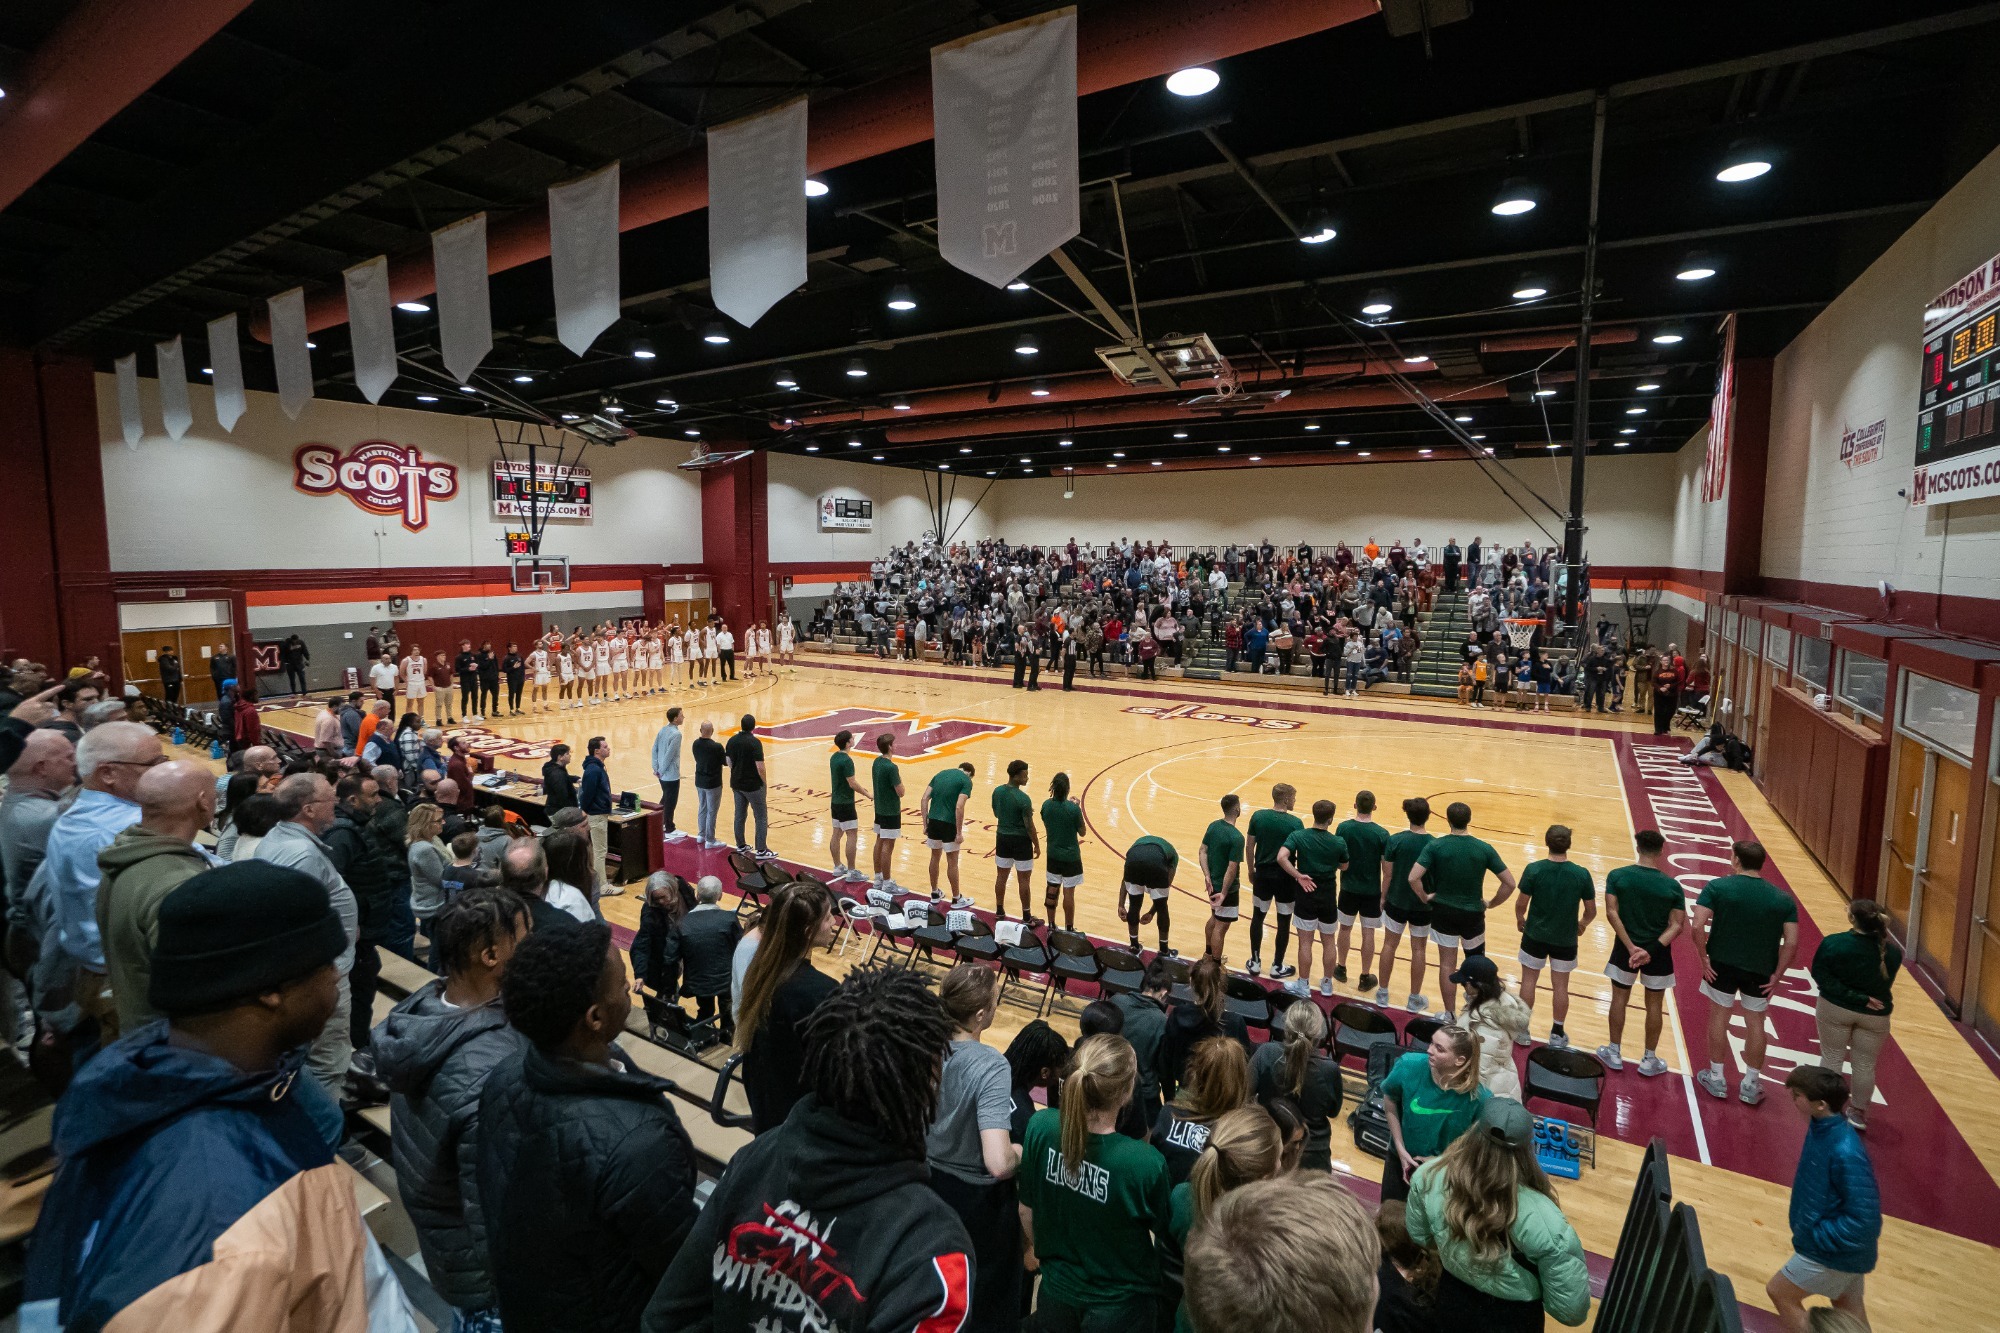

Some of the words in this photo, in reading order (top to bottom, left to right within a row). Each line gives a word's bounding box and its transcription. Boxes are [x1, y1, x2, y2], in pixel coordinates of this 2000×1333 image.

[360, 450, 405, 464] MARYVILLE
[495, 462, 546, 473] BOYDSN
[301, 449, 453, 526] SCOTS
[1913, 469, 1928, 505] M
[366, 495, 403, 506] COLLEGE
[498, 502, 511, 513] M
[513, 504, 577, 515] MCSOTS.COM
[579, 506, 591, 516] M
[512, 541, 527, 553] 30
[253, 645, 280, 671] M
[1630, 743, 1734, 852] MARYVILLE
[1046, 1147, 1110, 1204] LIONS
